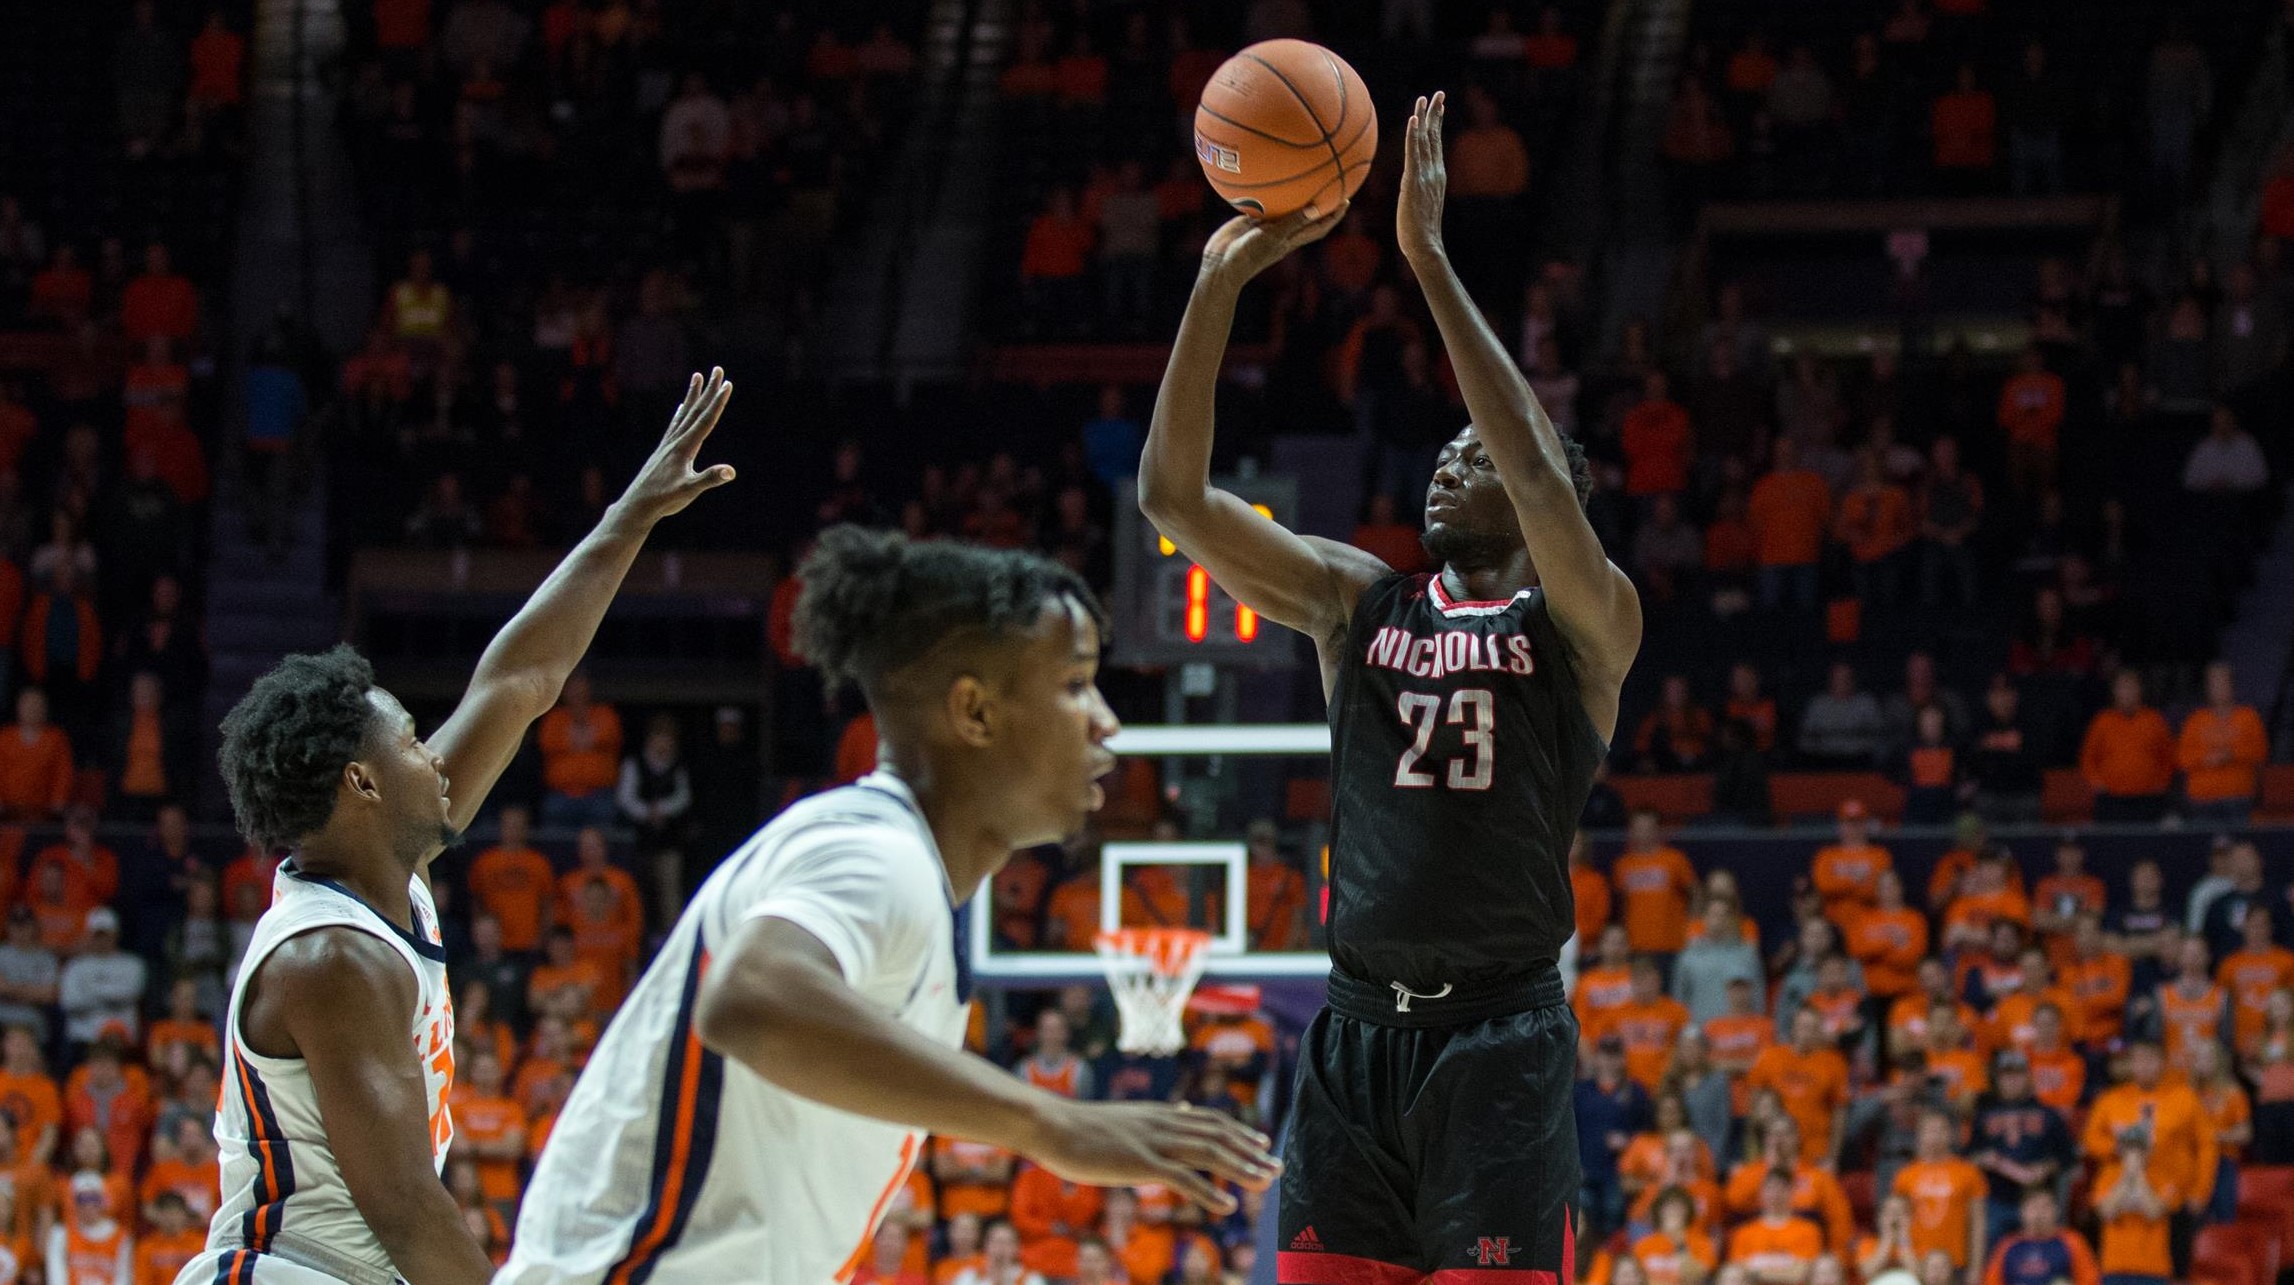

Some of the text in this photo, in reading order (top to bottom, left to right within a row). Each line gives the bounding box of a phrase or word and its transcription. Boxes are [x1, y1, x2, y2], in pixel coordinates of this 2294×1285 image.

[1365, 626, 1535, 679] NICHOLLS
[1394, 689, 1495, 791] 23
[1477, 1236, 1510, 1265] N
